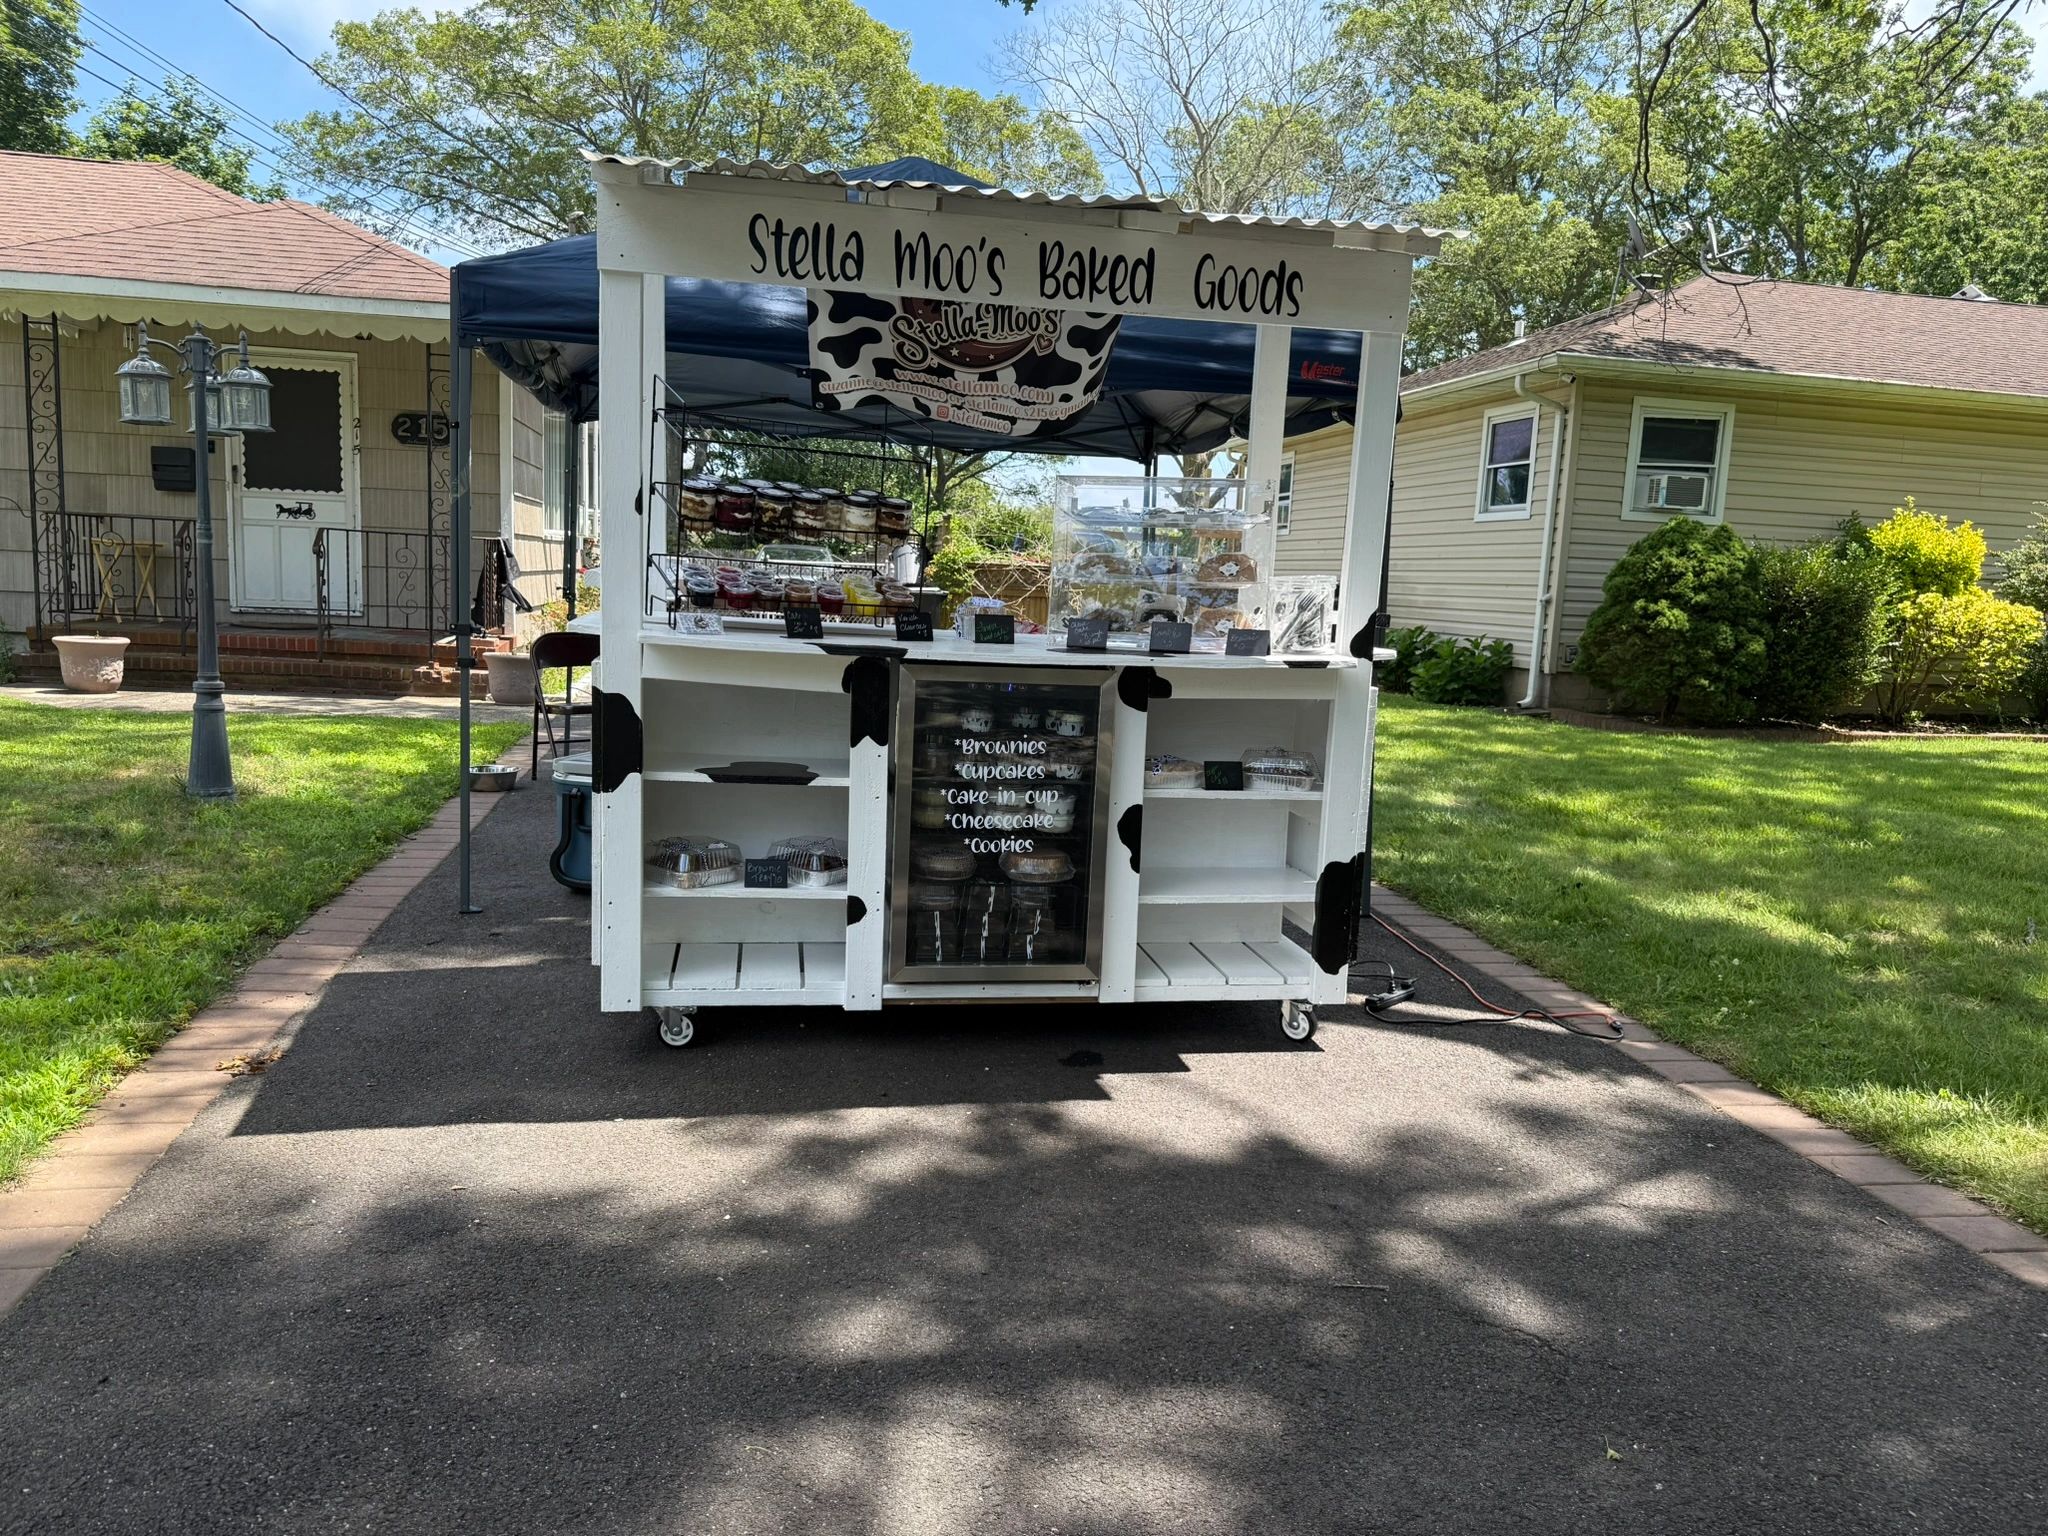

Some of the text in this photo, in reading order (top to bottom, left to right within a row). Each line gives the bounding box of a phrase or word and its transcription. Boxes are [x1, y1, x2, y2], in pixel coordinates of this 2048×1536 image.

[748, 213, 1303, 317] Stella Moo's Baked Goods
[398, 417, 448, 440] 215
